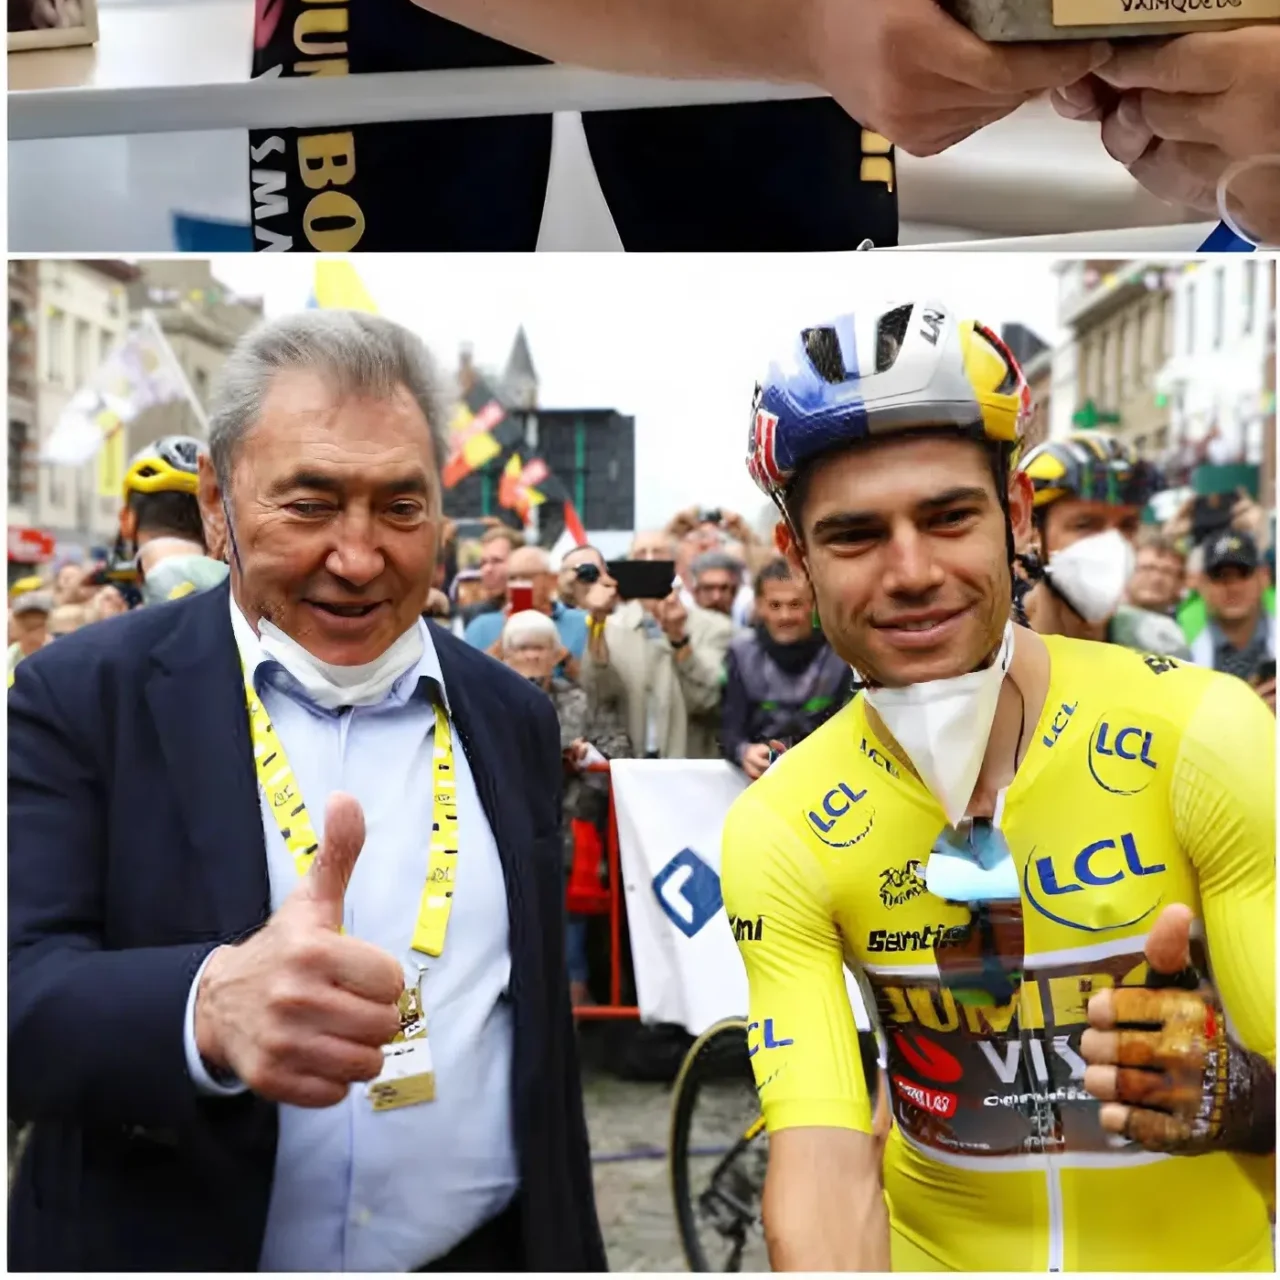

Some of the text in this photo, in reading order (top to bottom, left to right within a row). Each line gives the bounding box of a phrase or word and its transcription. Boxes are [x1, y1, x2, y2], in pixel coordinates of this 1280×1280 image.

[1095, 722, 1158, 769] LCL
[808, 782, 868, 833] LCL
[1035, 832, 1166, 896] LCL
